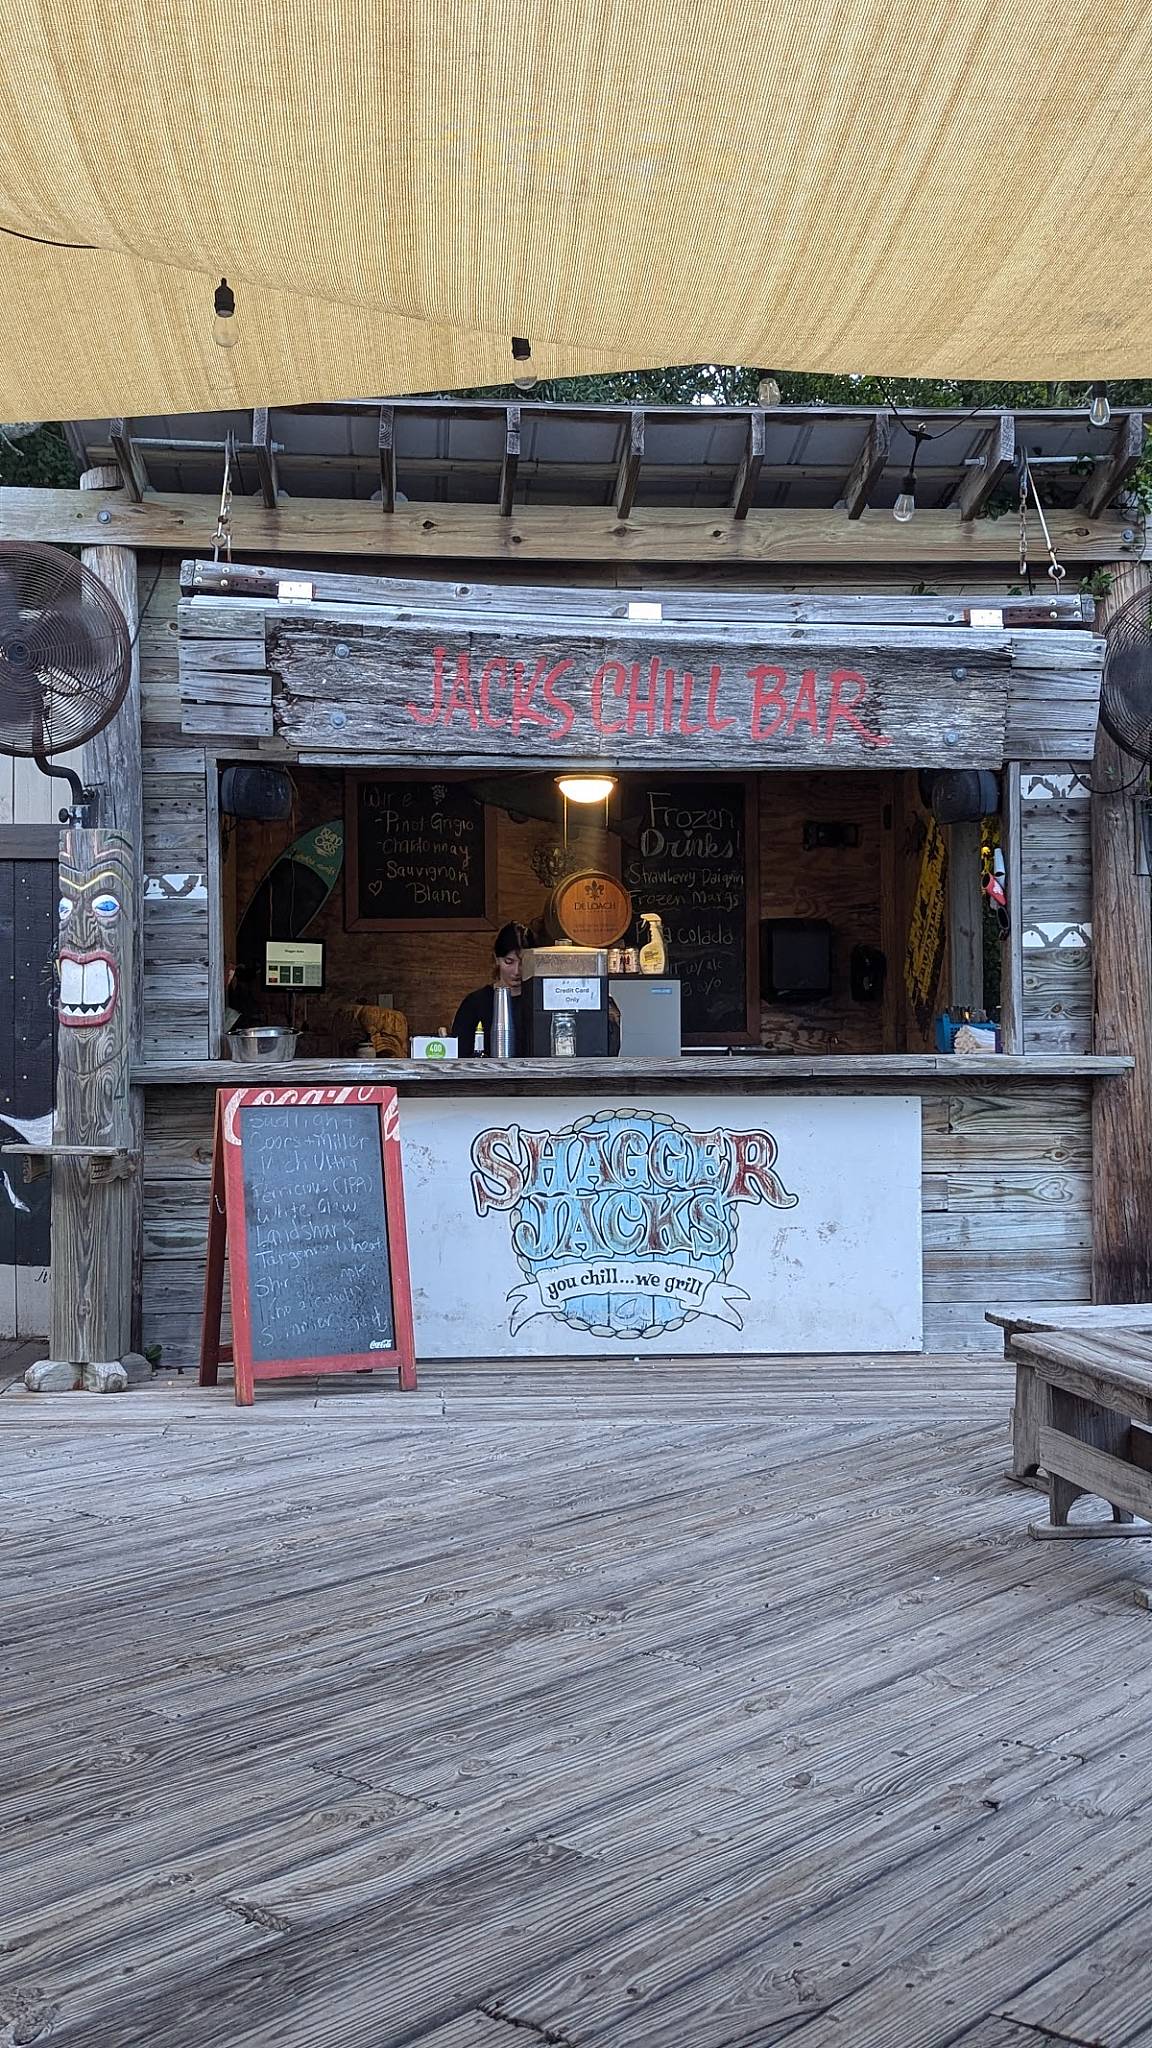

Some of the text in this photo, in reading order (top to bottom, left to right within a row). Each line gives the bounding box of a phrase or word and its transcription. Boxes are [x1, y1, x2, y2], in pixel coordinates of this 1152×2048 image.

[408, 646, 893, 747] JACKS CHILL BAR
[646, 791, 735, 830] Frozen
[431, 813, 474, 837] Grigio
[640, 829, 740, 858] Drinks!
[629, 862, 697, 888] Strawberry
[405, 881, 461, 905] Blanc
[624, 889, 739, 912] Frozen Margs
[636, 919, 673, 943] Pia
[678, 922, 734, 945] colada
[429, 1043, 443, 1052] 400
[471, 1124, 799, 1217] SHAGGER
[514, 1188, 730, 1260] JACKS
[546, 1276, 578, 1299] you
[664, 1277, 704, 1296] grill
